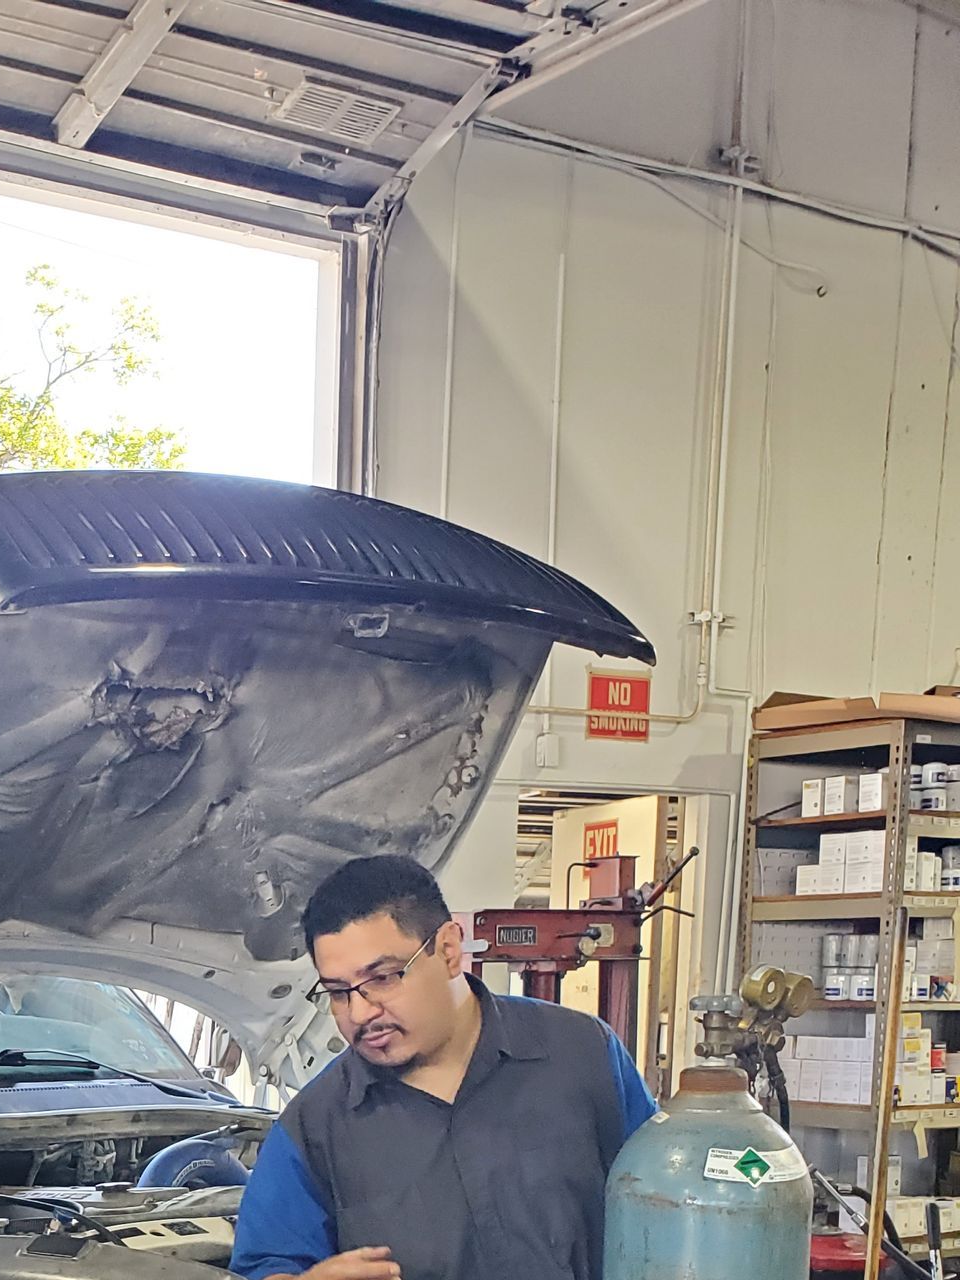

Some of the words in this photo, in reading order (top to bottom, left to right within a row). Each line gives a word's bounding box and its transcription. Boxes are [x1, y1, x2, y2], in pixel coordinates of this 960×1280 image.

[608, 681, 631, 706] NO
[590, 709, 646, 732] SMOKING
[585, 827, 617, 859] EXIT
